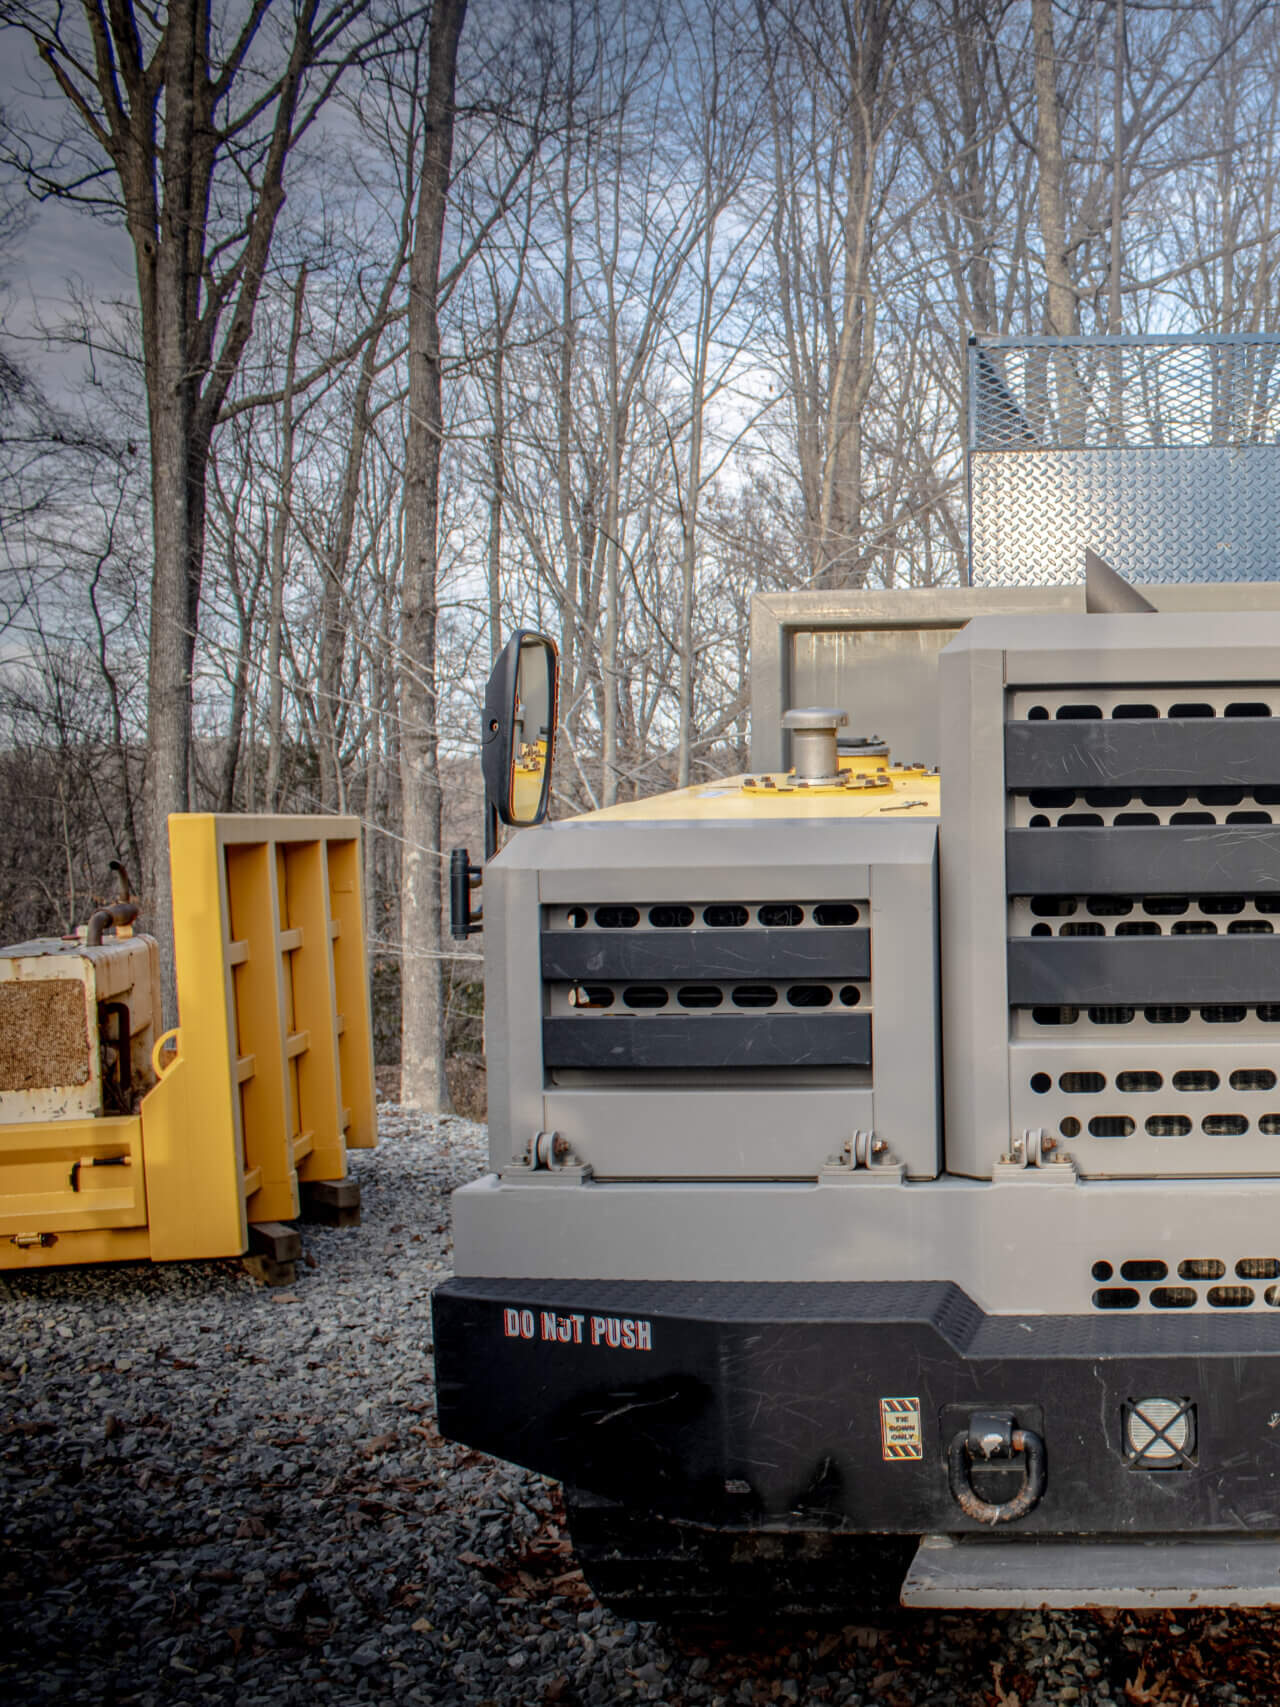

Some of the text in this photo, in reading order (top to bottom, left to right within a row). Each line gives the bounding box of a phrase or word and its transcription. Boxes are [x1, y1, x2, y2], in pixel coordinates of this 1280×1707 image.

[503, 1308, 652, 1351] DO NOT PUSH
[888, 1424, 916, 1432] DOWN
[890, 1433, 914, 1441] ONLY
